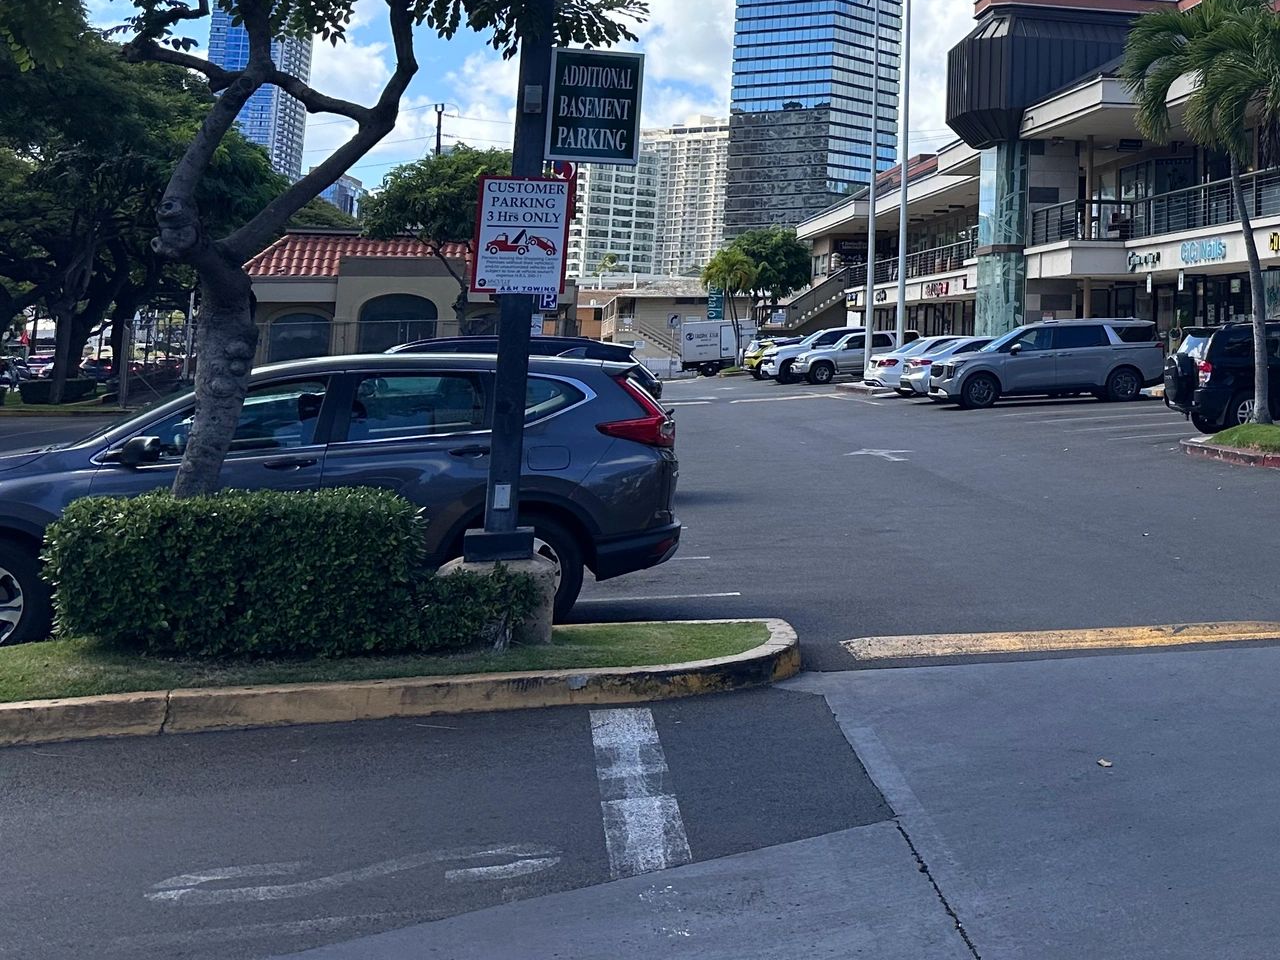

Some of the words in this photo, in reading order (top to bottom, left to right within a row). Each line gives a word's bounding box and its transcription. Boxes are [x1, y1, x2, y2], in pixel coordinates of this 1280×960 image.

[561, 65, 633, 90] ADDITIONAL
[559, 96, 631, 120] BASEMENT
[556, 126, 627, 151] PARKING
[487, 181, 565, 195] CUSTOMER
[491, 196, 556, 209] PARKING
[487, 211, 494, 221] 3
[498, 211, 519, 222] Hrs
[522, 212, 561, 223] ONLY
[1200, 237, 1225, 259] Nails
